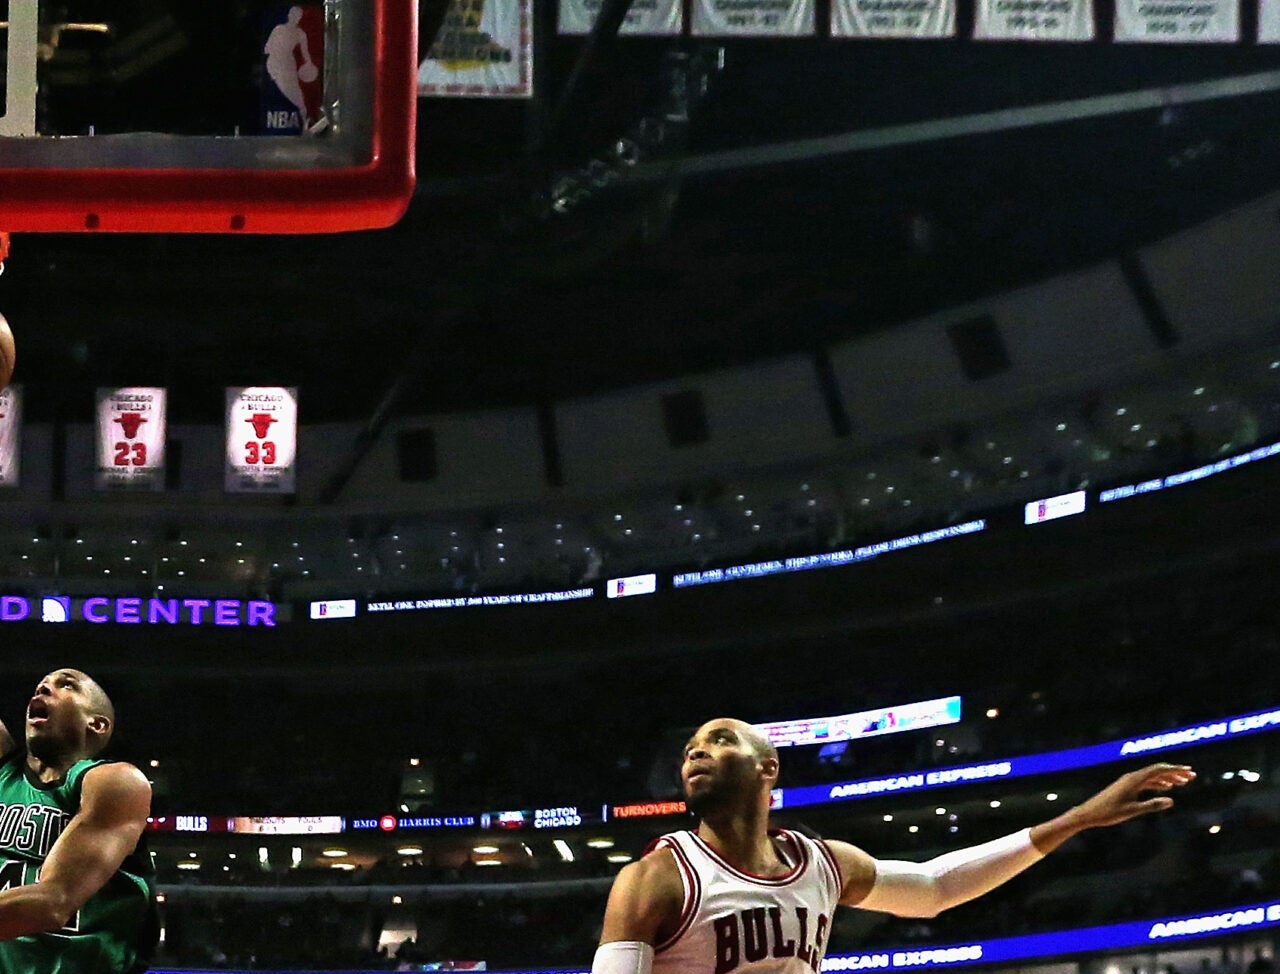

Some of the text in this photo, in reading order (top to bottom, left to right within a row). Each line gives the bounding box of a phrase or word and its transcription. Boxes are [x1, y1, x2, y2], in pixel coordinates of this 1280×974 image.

[266, 110, 300, 129] NBA
[114, 441, 147, 466] 23
[245, 441, 276, 464] 33
[82, 597, 277, 629] CENTER
[1120, 722, 1227, 755] AMERICAN
[829, 762, 1012, 798] AMERICAN EXPRESS
[534, 807, 578, 819] BOSTON
[613, 801, 687, 818] TURNOVERS
[175, 815, 208, 832] BULLS
[353, 816, 475, 829] BMO HARRIS CLUB
[534, 816, 582, 829] CHICAGO
[1149, 907, 1265, 939] AMERICAN
[892, 945, 983, 967] EXPRESS
